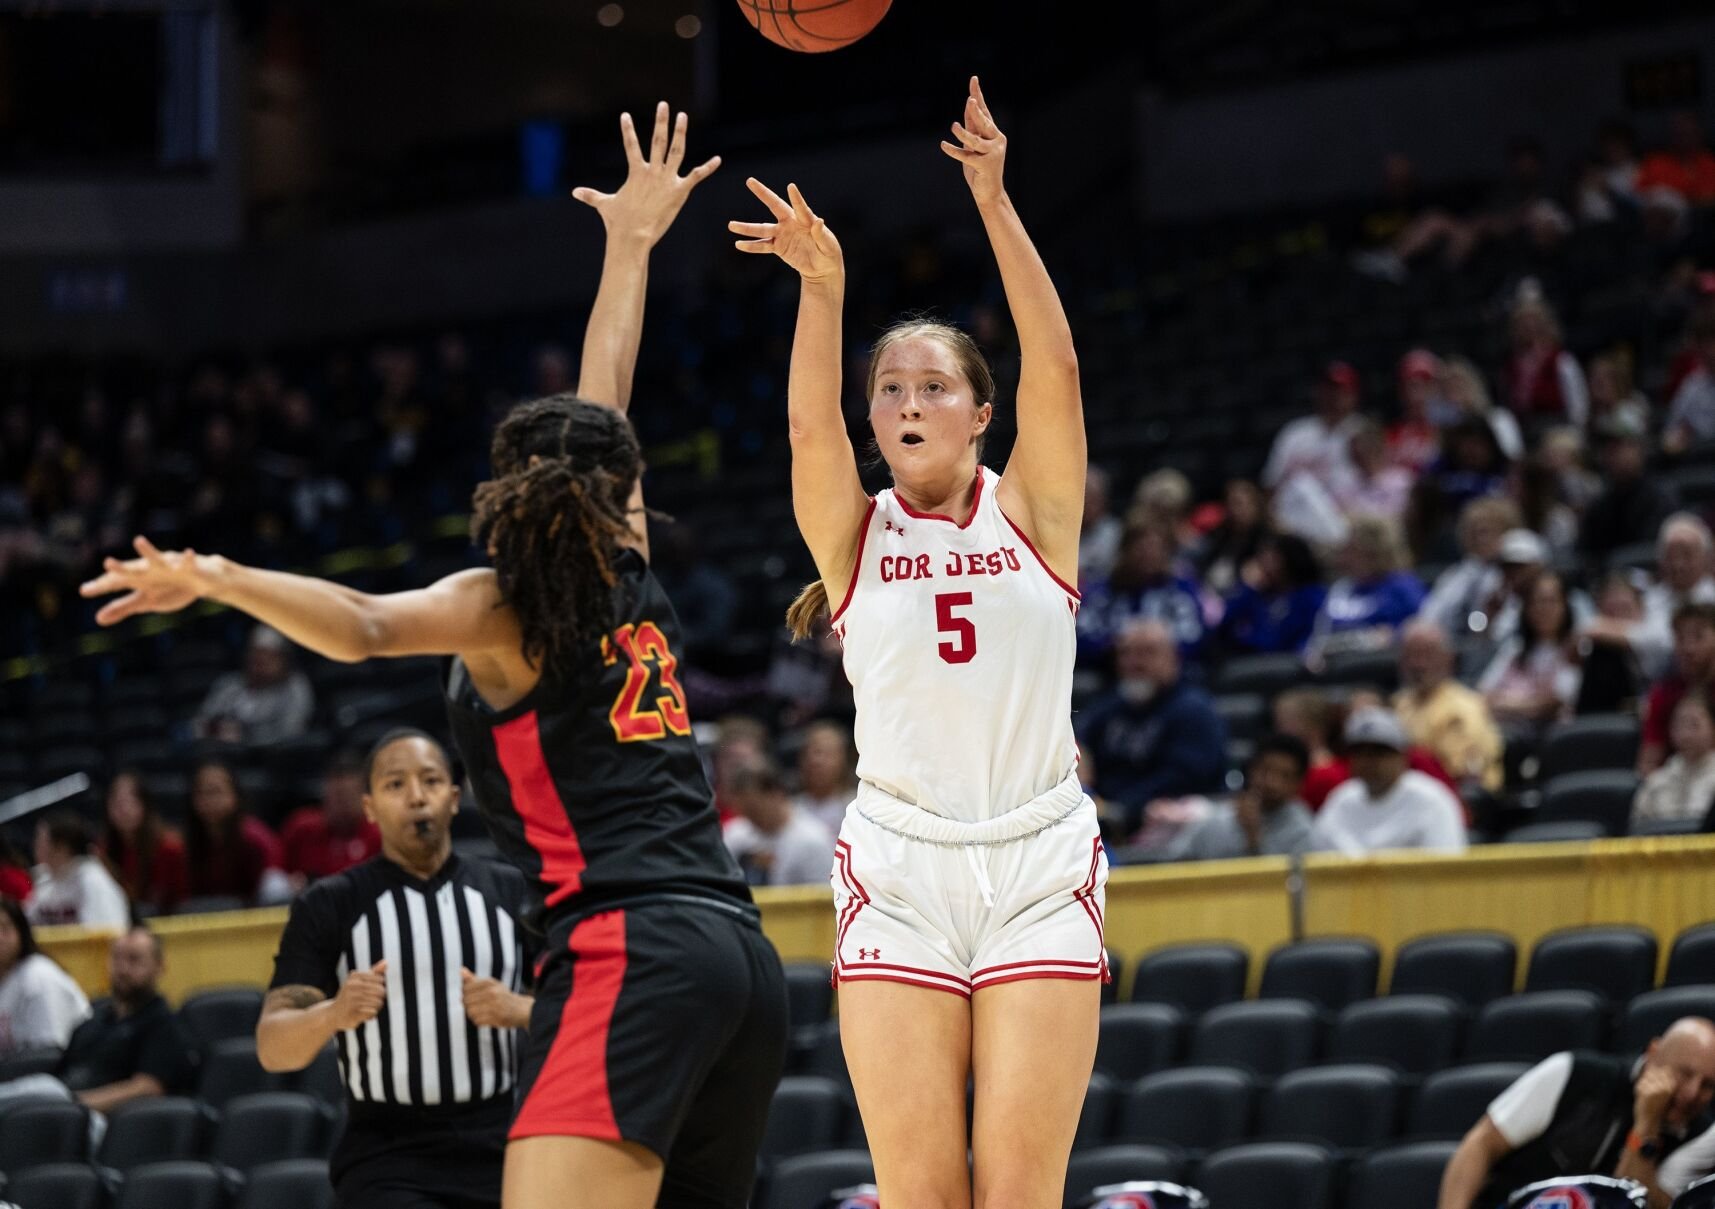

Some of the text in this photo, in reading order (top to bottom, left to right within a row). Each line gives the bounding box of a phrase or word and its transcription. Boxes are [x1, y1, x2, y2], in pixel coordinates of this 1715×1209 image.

[880, 546, 1022, 583] COR JESU
[935, 591, 977, 664] 5
[601, 621, 692, 743] 23
